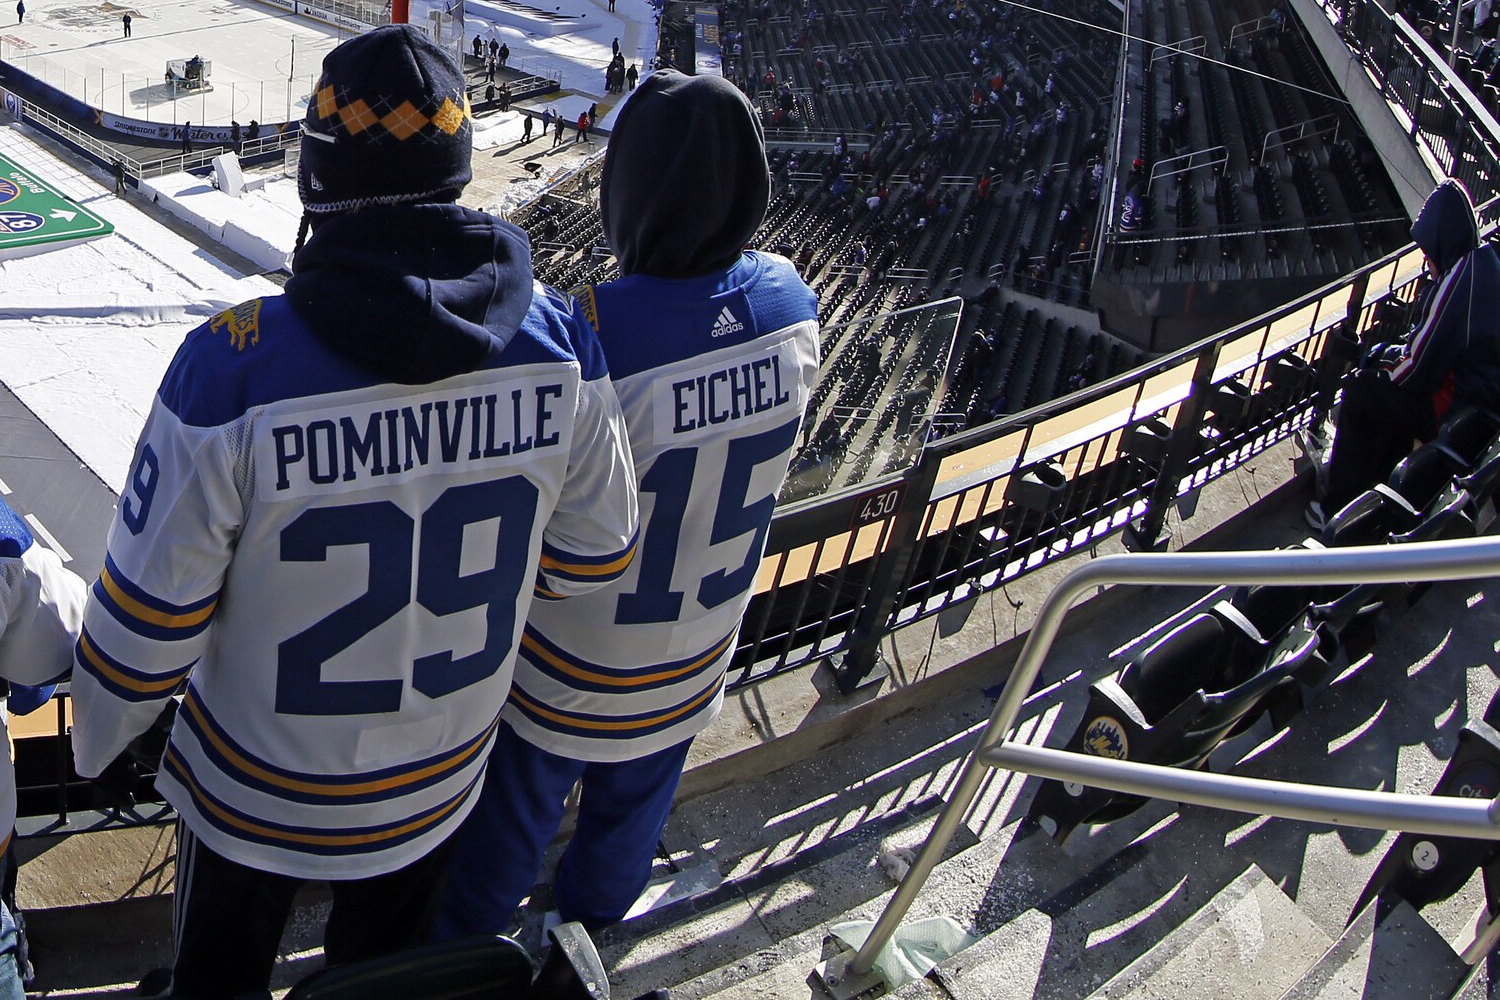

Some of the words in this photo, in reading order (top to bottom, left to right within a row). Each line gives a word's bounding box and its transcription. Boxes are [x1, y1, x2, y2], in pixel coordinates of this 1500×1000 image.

[114, 121, 157, 136] BRIDGESTONE
[171, 126, 214, 141] Wnter
[9, 172, 45, 194] Buffalo
[710, 321, 744, 338] adidas
[672, 354, 790, 434] EICHEL
[273, 383, 564, 492] POMINVILLE
[859, 490, 898, 522] 430
[614, 417, 800, 627] 15
[274, 473, 541, 717] 29
[1420, 850, 1430, 862] 2
